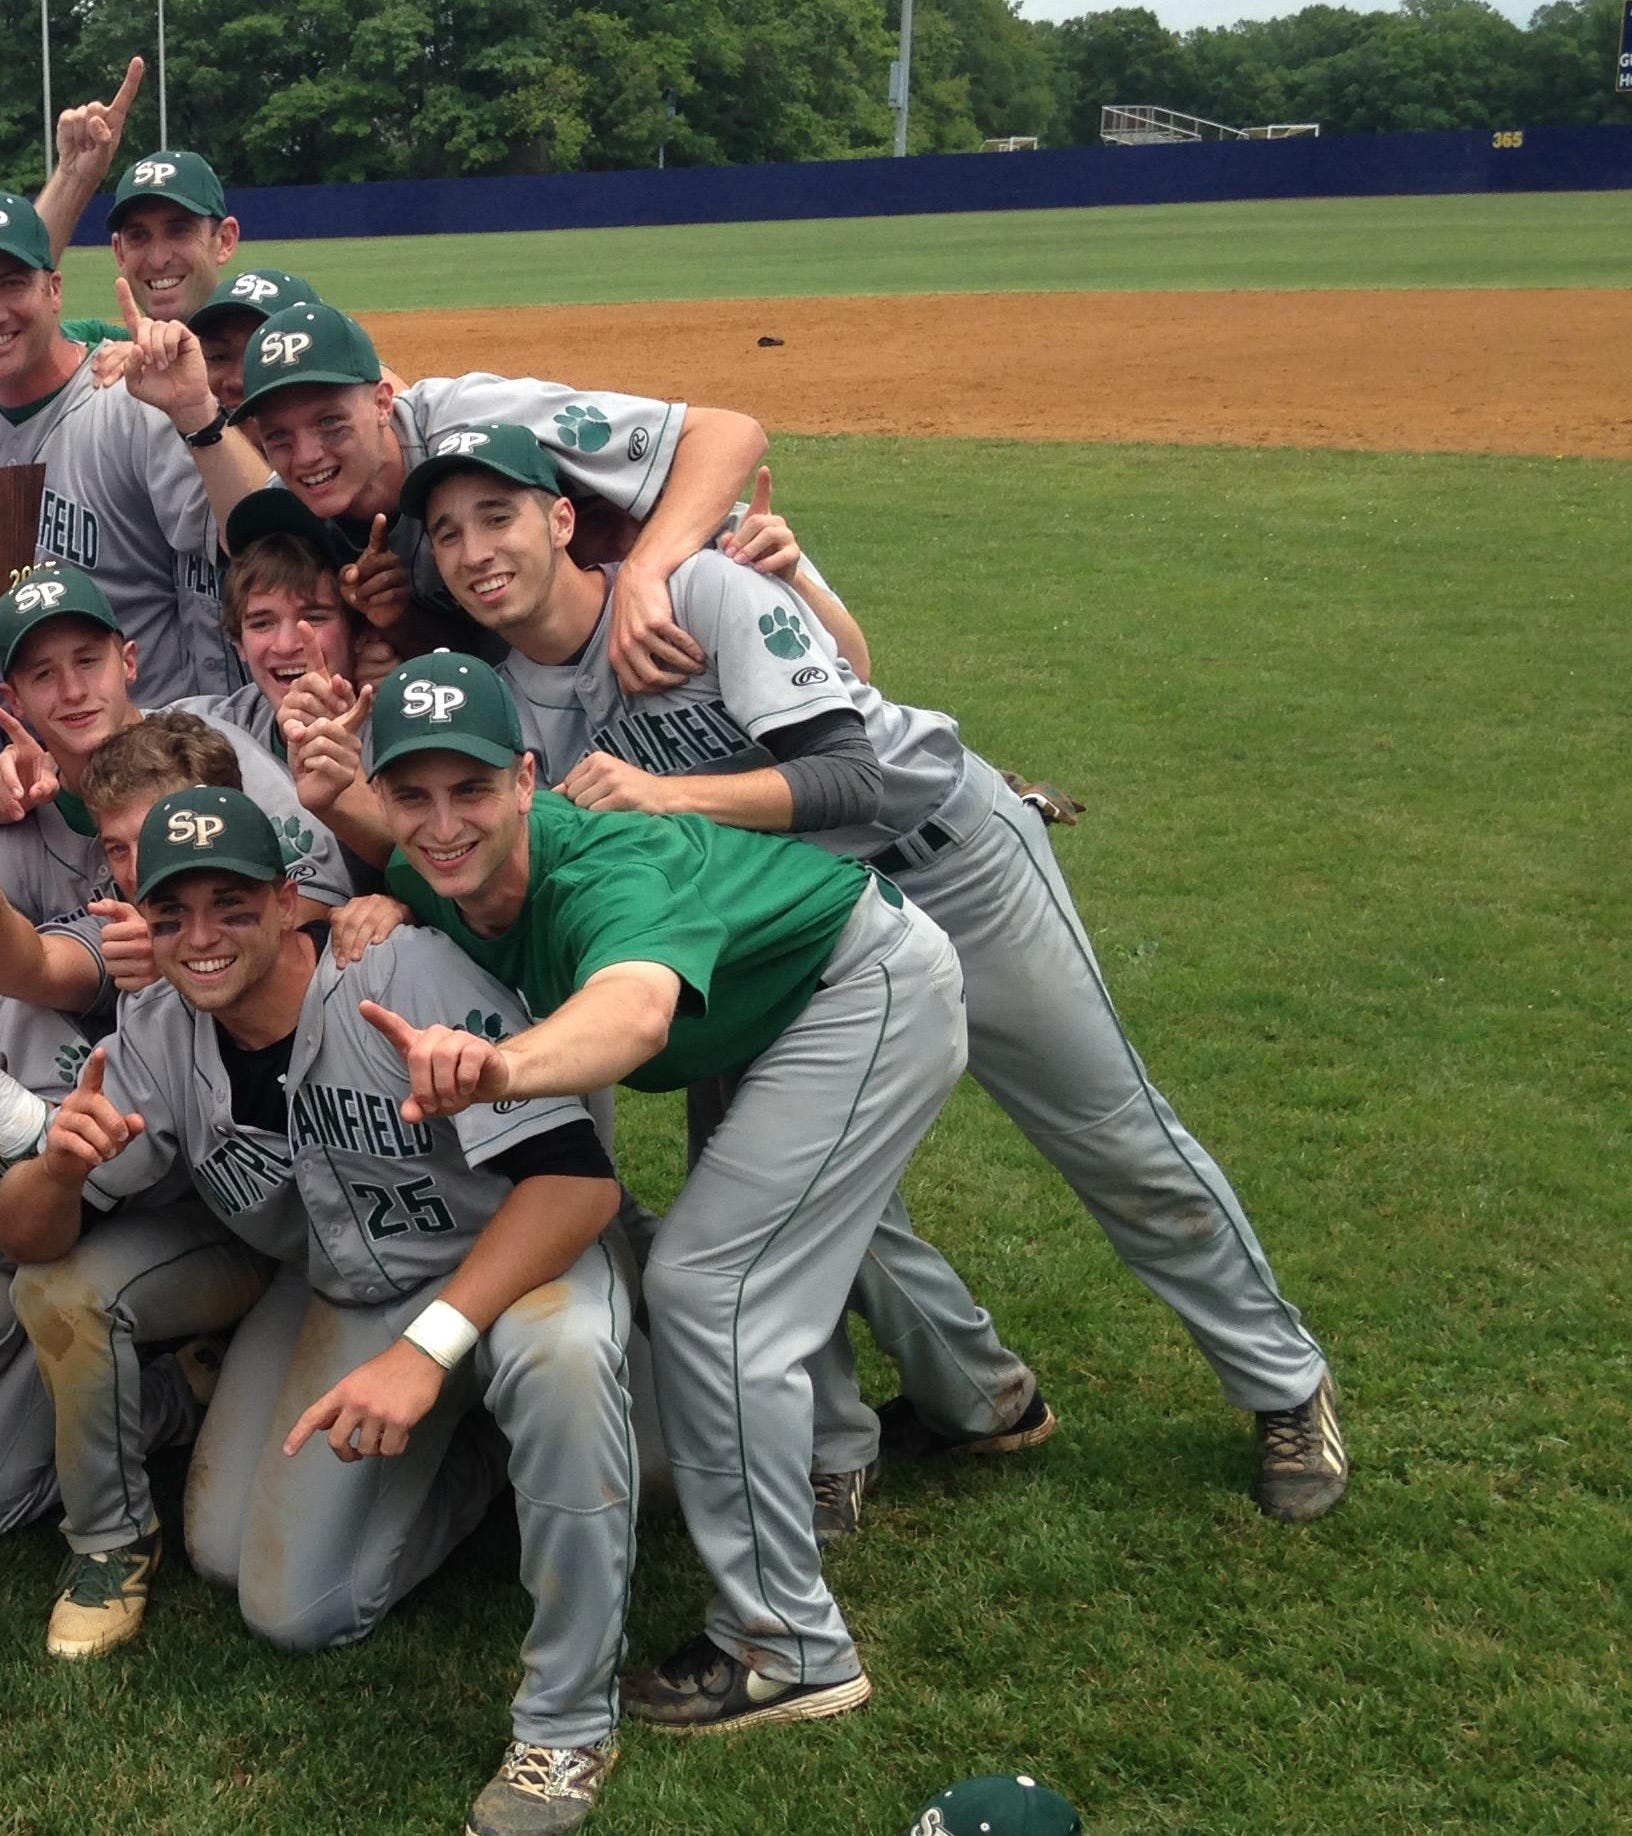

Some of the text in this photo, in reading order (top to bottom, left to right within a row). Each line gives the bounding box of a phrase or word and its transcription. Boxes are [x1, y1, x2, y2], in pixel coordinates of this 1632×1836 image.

[1492, 131, 1522, 148] 365
[133, 160, 177, 186] SP
[231, 274, 281, 303] SP
[259, 331, 314, 368] SP
[436, 431, 491, 456] SP
[14, 581, 67, 614] SP
[400, 678, 467, 723] SP
[166, 808, 226, 850] SP
[348, 1174, 458, 1242] 25
